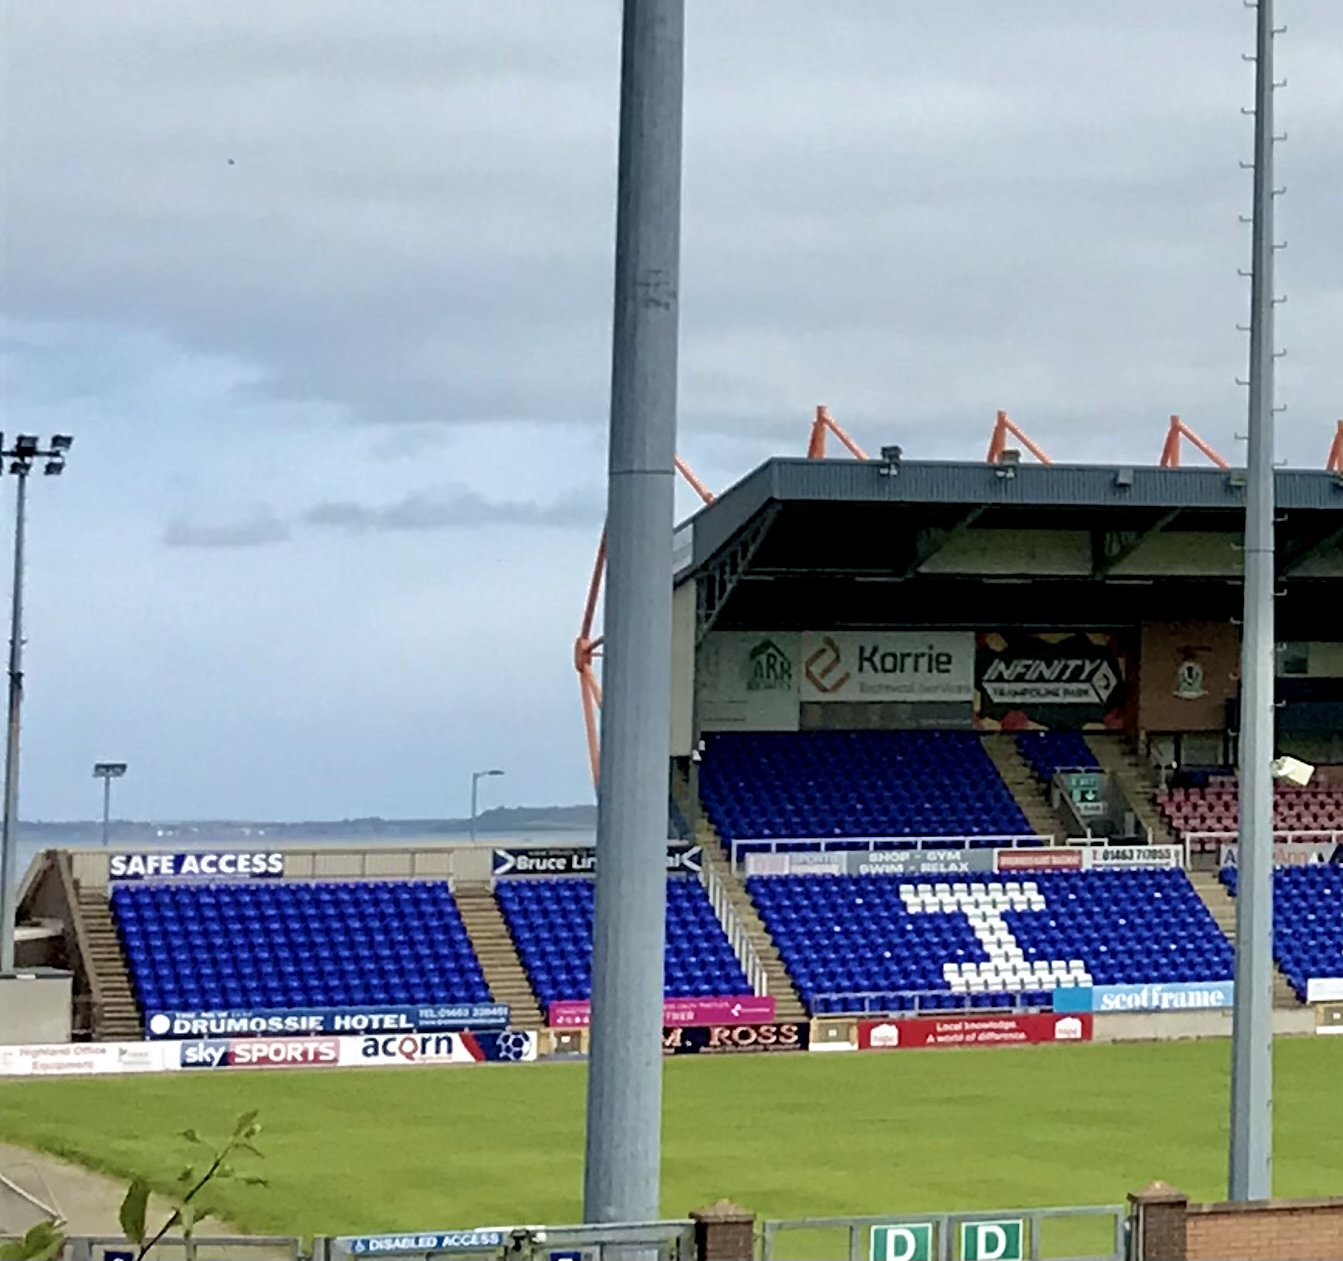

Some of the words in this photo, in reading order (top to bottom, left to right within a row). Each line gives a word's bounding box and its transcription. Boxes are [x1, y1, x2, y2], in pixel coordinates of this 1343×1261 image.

[858, 644, 952, 673] Korrie
[982, 658, 1101, 680] INFINITY
[110, 854, 174, 875] SAFE
[180, 853, 283, 874] ACCESS
[515, 855, 567, 870] Bruce
[926, 851, 961, 861] GYM
[1102, 849, 1134, 861] 01463
[920, 862, 969, 873] RELAX
[1101, 985, 1224, 1010] scotframe
[173, 1016, 325, 1035] DRUMOSSIE
[334, 1013, 414, 1031] HOTEL
[936, 1022, 962, 1032] Local
[709, 1024, 798, 1047] ROSS
[965, 1032, 977, 1041] of
[184, 1041, 225, 1067] sky
[233, 1042, 336, 1062] SPORTS
[362, 1035, 452, 1060] acorn
[369, 1237, 437, 1251] DISABLED
[441, 1233, 500, 1248] ACCESS
[886, 1228, 917, 1261] D
[977, 1224, 1007, 1261] D
